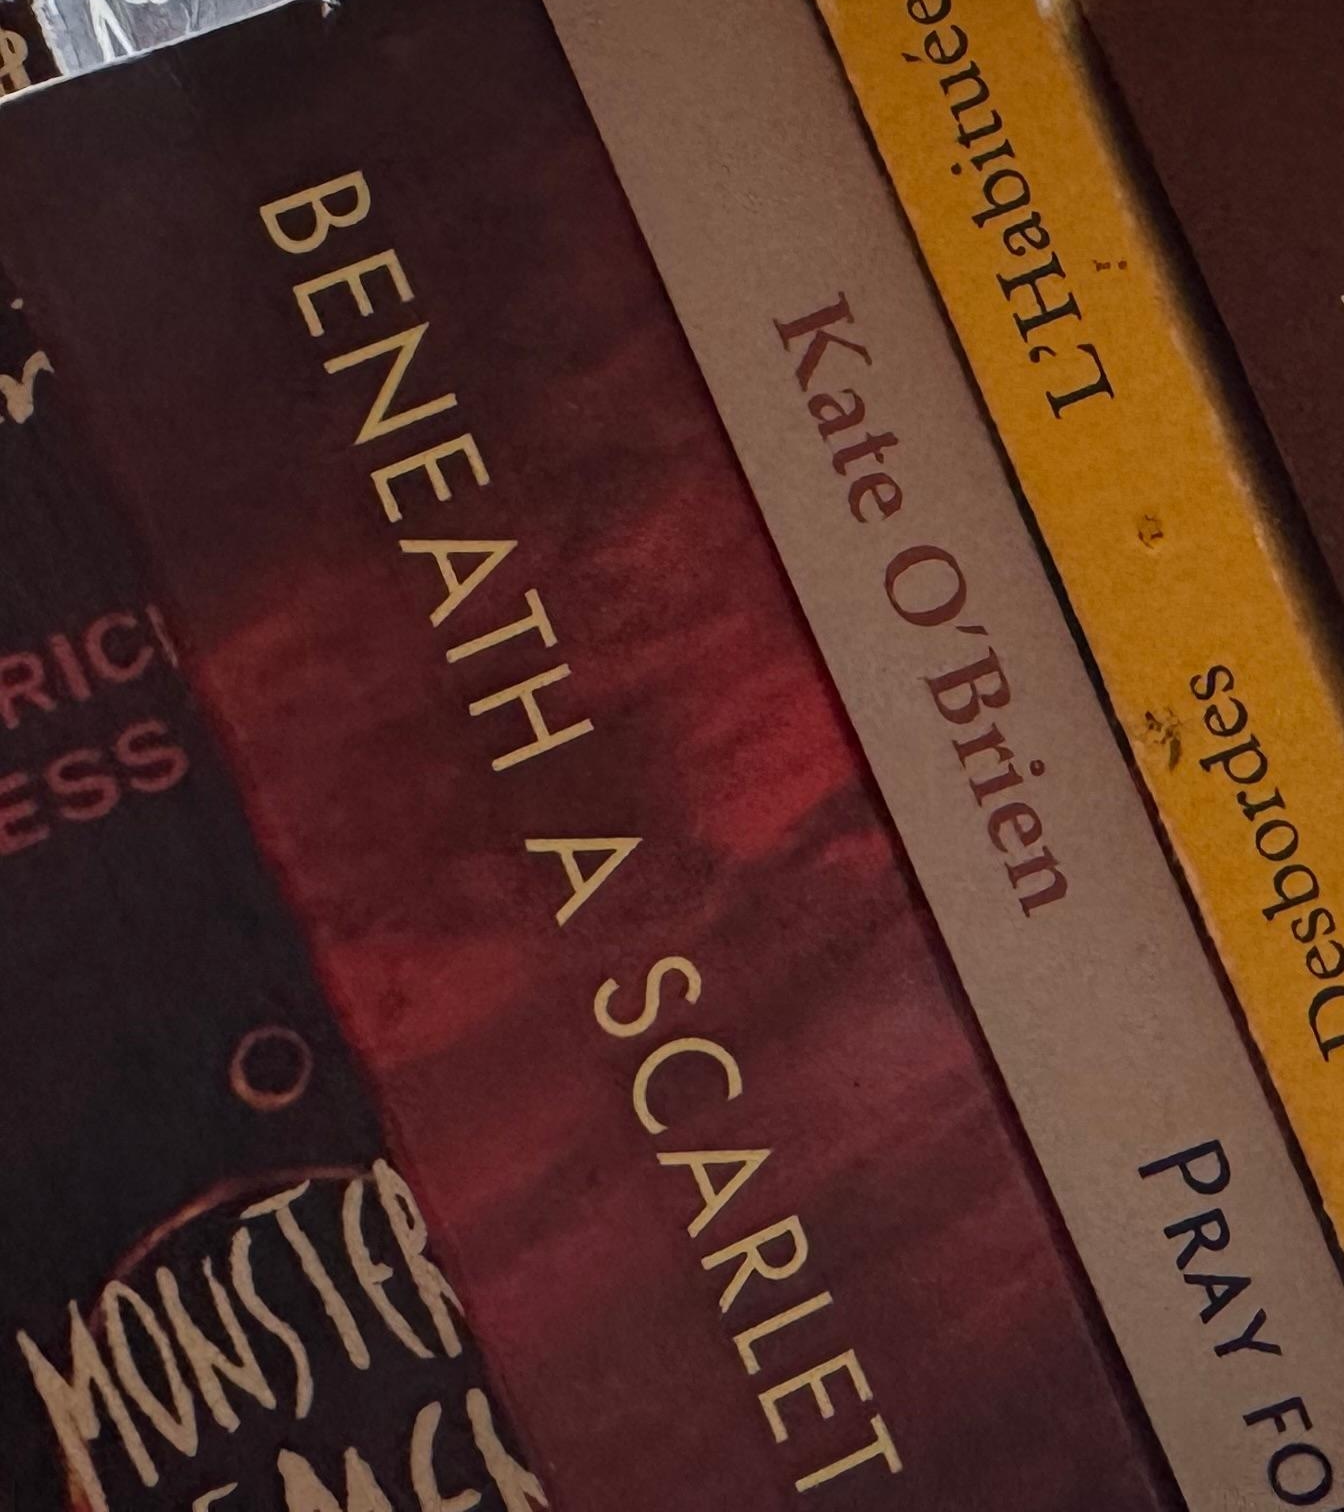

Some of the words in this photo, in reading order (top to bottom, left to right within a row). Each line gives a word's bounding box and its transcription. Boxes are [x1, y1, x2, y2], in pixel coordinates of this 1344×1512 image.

[259, 170, 595, 772] BENEATH
[525, 836, 643, 926] A
[594, 956, 902, 1493] SCARLET
[772, 291, 904, 524] Kate
[883, 544, 1070, 919] O'Brien
[1138, 1138, 1283, 1357] PRAY
